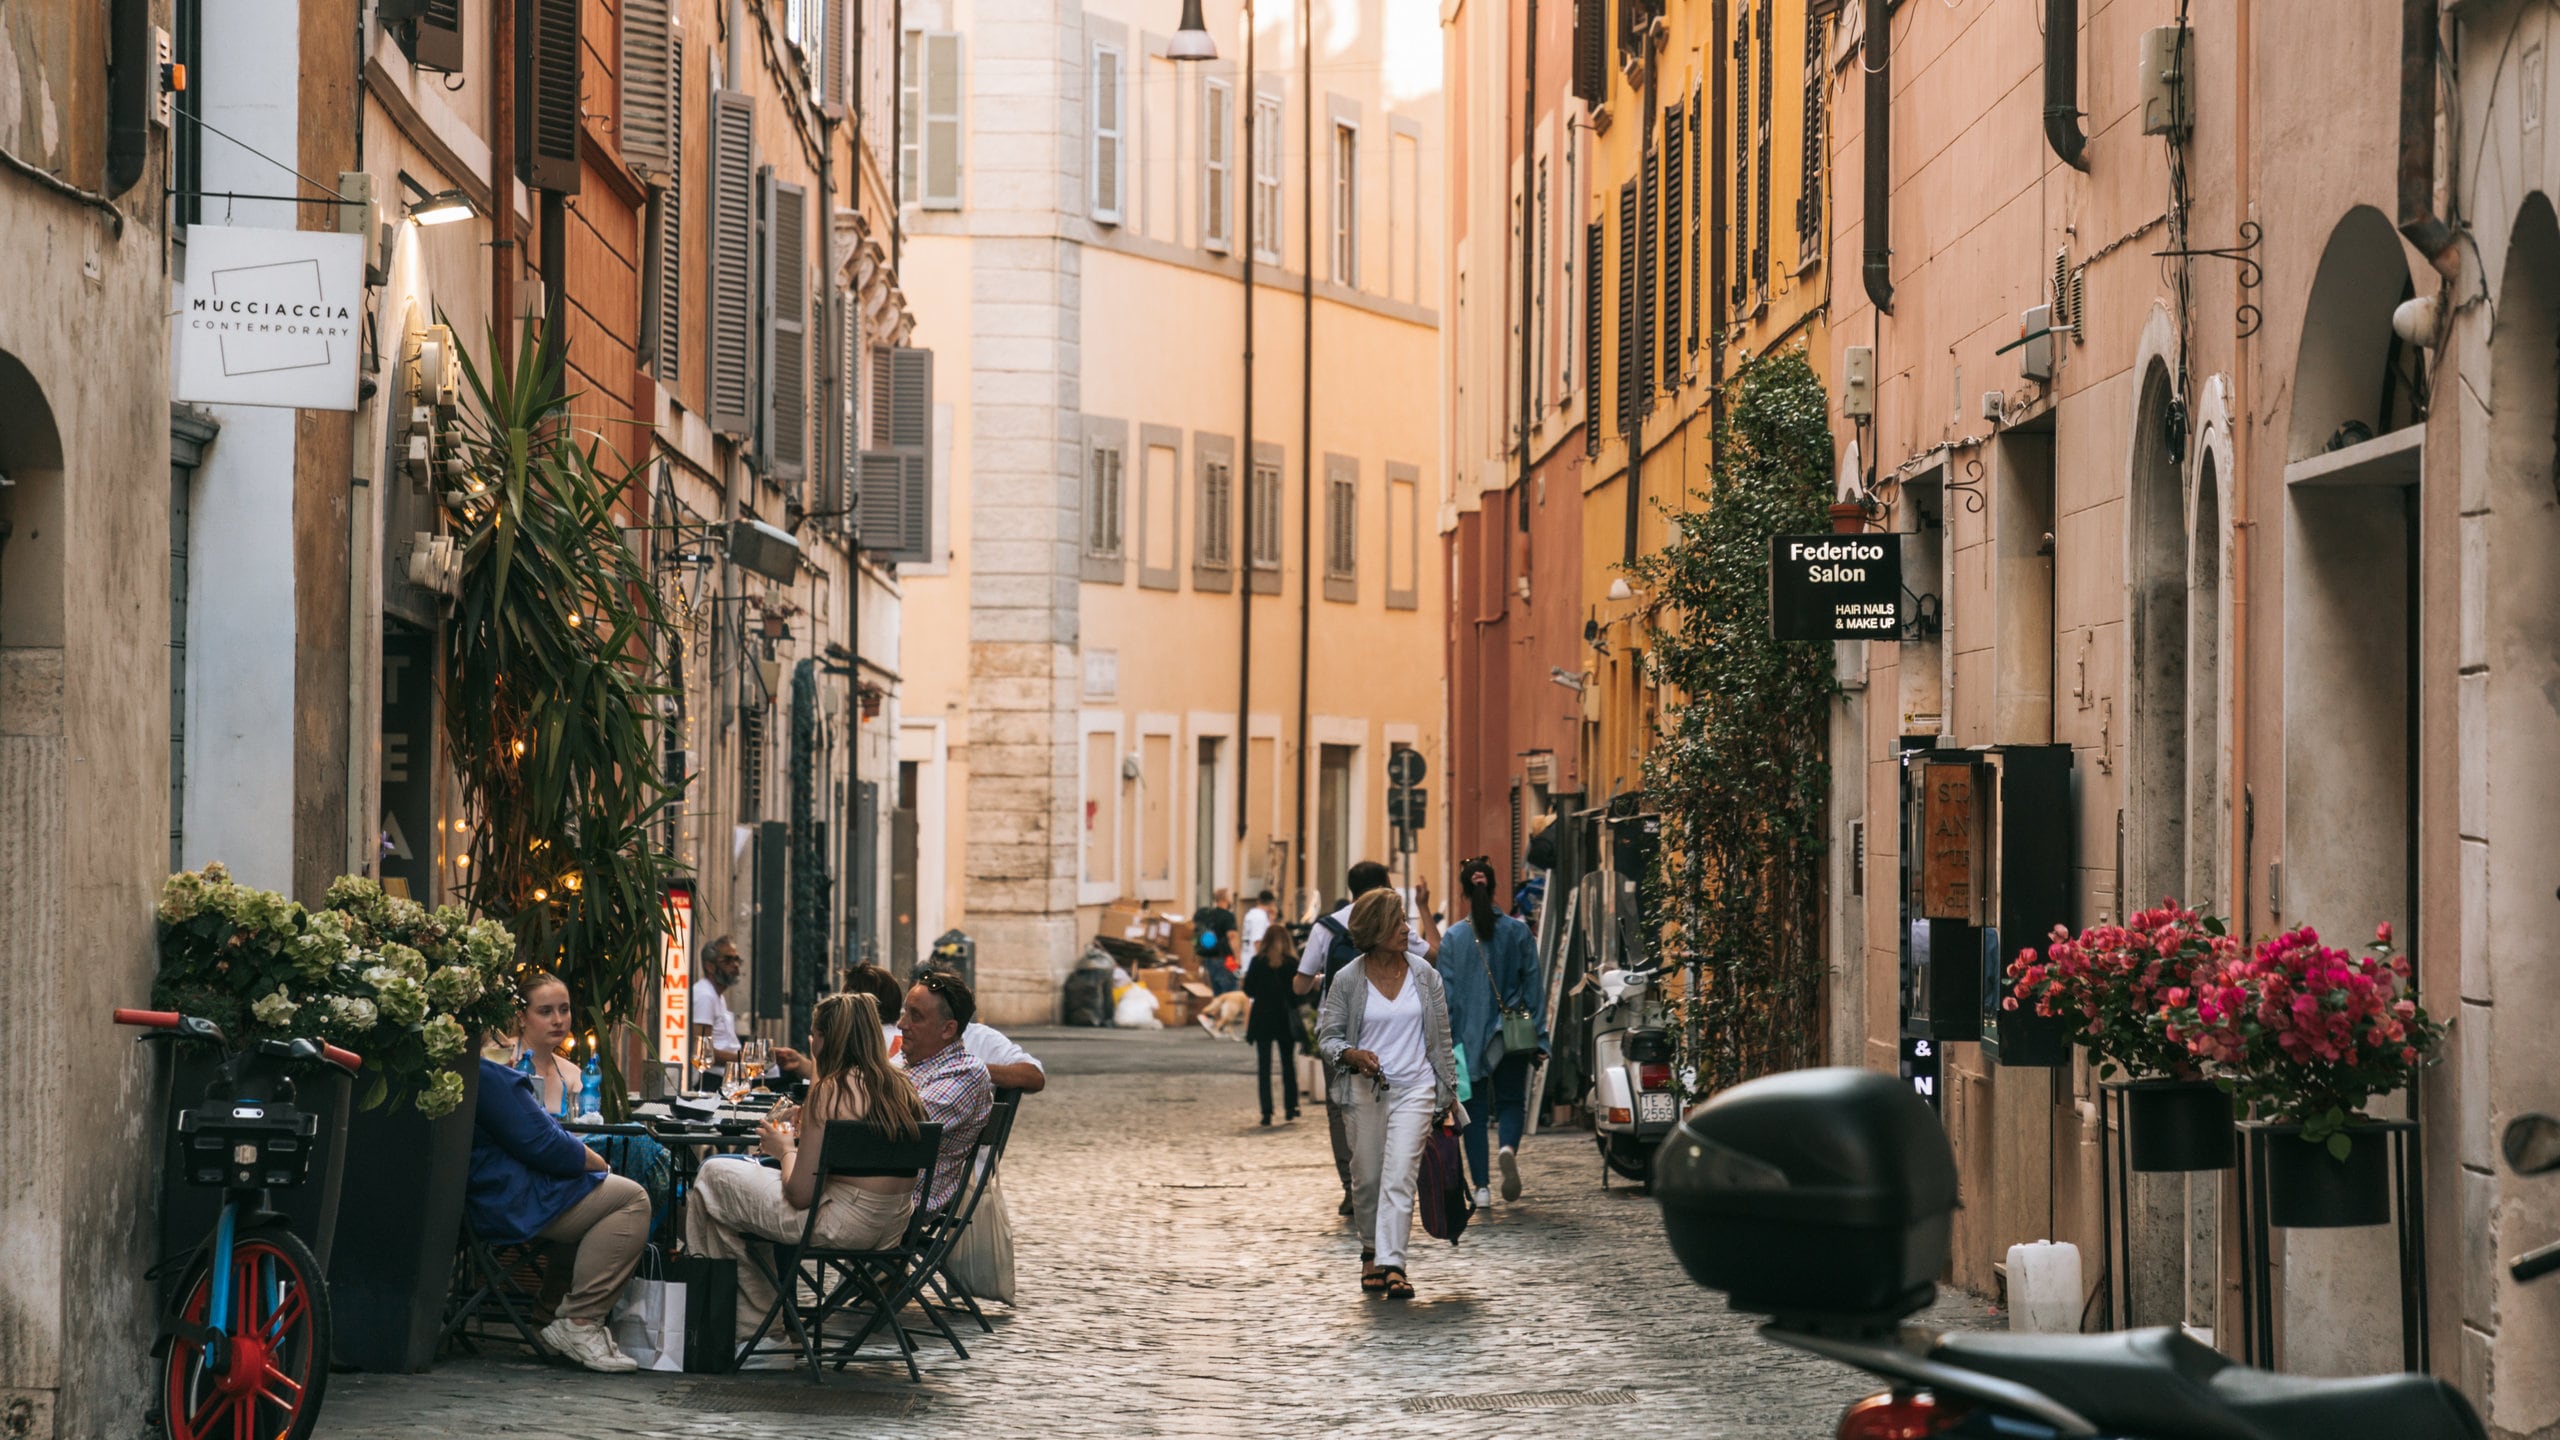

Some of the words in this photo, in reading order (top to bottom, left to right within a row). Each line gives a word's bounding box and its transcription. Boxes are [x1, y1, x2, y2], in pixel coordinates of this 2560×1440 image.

[193, 299, 349, 319] MUCCIACCIA
[192, 320, 349, 336] CONTEMPORARY
[1790, 541, 1884, 561] Federico
[1808, 563, 1866, 583] Salon
[1836, 604, 1862, 615] HAIR
[1863, 603, 1895, 615] NAILS
[1835, 619, 1843, 629] &
[1846, 618, 1878, 629] MAKE
[1879, 617, 1896, 629] UP
[670, 896, 690, 907] PEN
[1914, 1040, 1932, 1057] &
[1643, 1094, 1659, 1108] TE
[1664, 1094, 1673, 1107] 3
[1643, 1108, 1674, 1121] 2559
